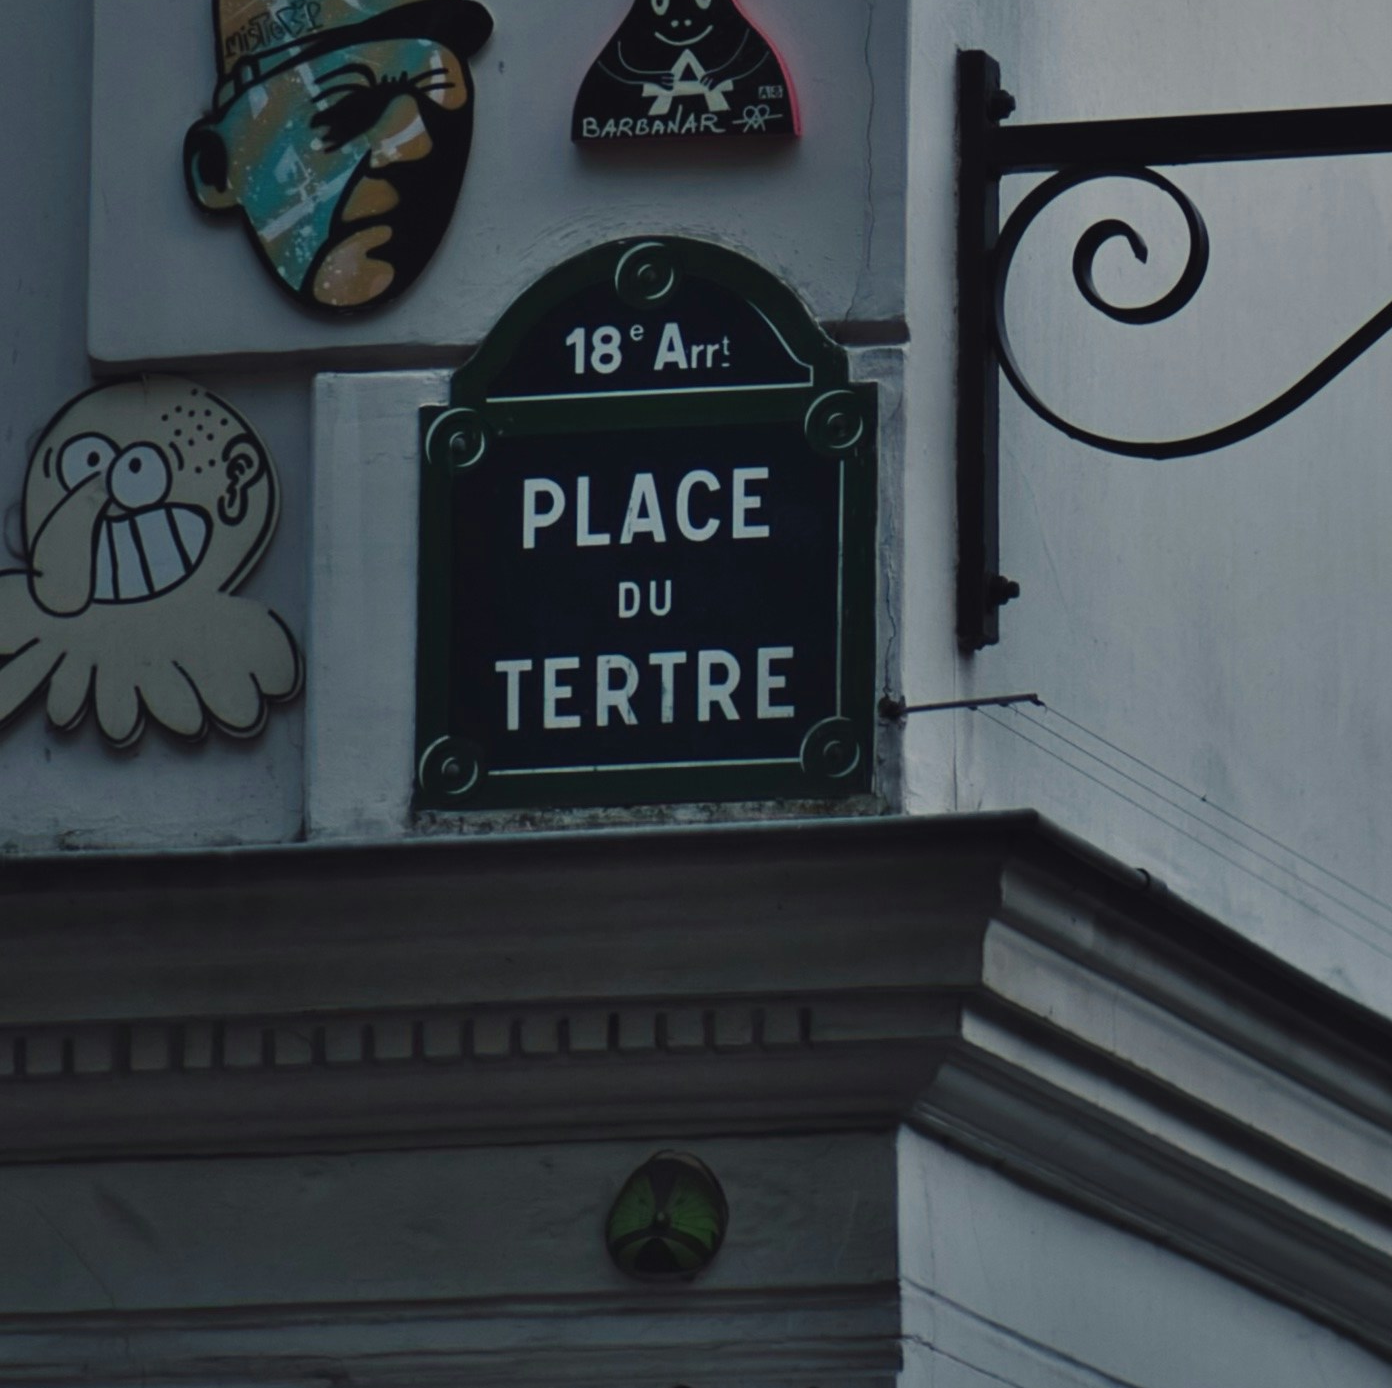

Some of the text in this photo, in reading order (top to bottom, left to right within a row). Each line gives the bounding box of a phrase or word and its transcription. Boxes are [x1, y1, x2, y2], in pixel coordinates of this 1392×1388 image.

[582, 105, 727, 138] BARBANAR
[565, 324, 645, 375] 18e
[522, 466, 770, 550] PLACE
[618, 579, 672, 619] DU
[494, 647, 797, 731] TERTRE
